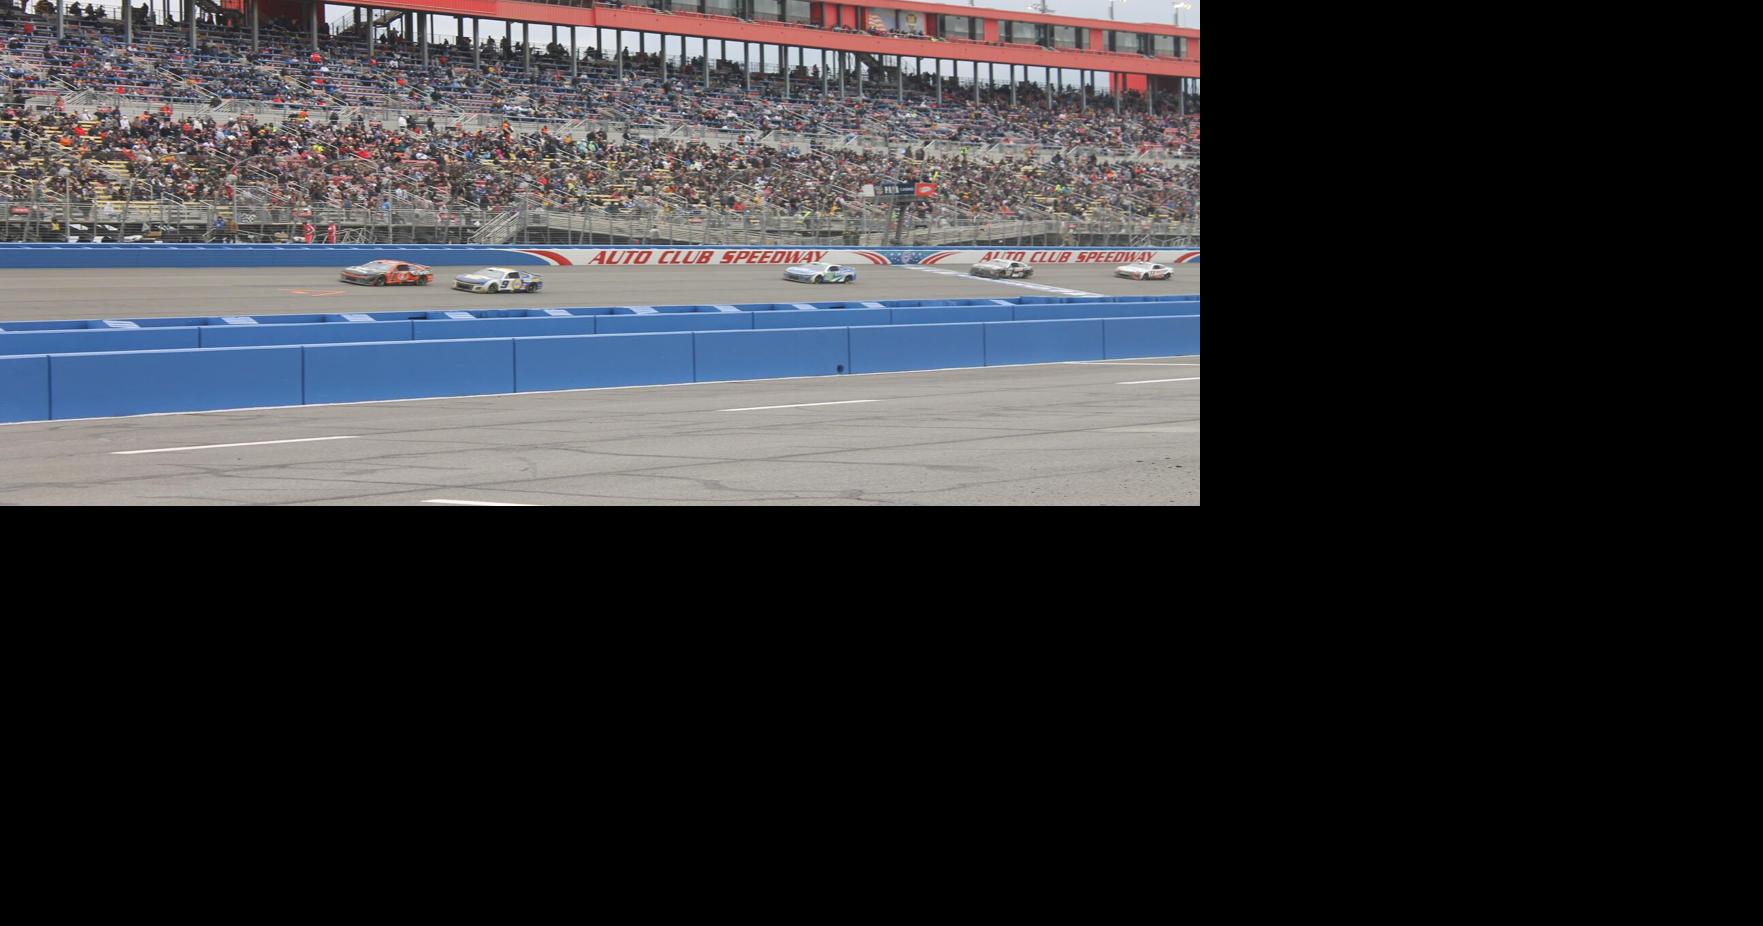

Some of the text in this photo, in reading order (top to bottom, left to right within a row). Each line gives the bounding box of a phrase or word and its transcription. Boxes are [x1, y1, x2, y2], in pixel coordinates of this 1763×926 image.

[588, 250, 827, 265] AUTO CLUB SPEEDWAY
[979, 251, 1157, 263] AUTO CLUB SPEEDWAY
[500, 280, 509, 289] 9
